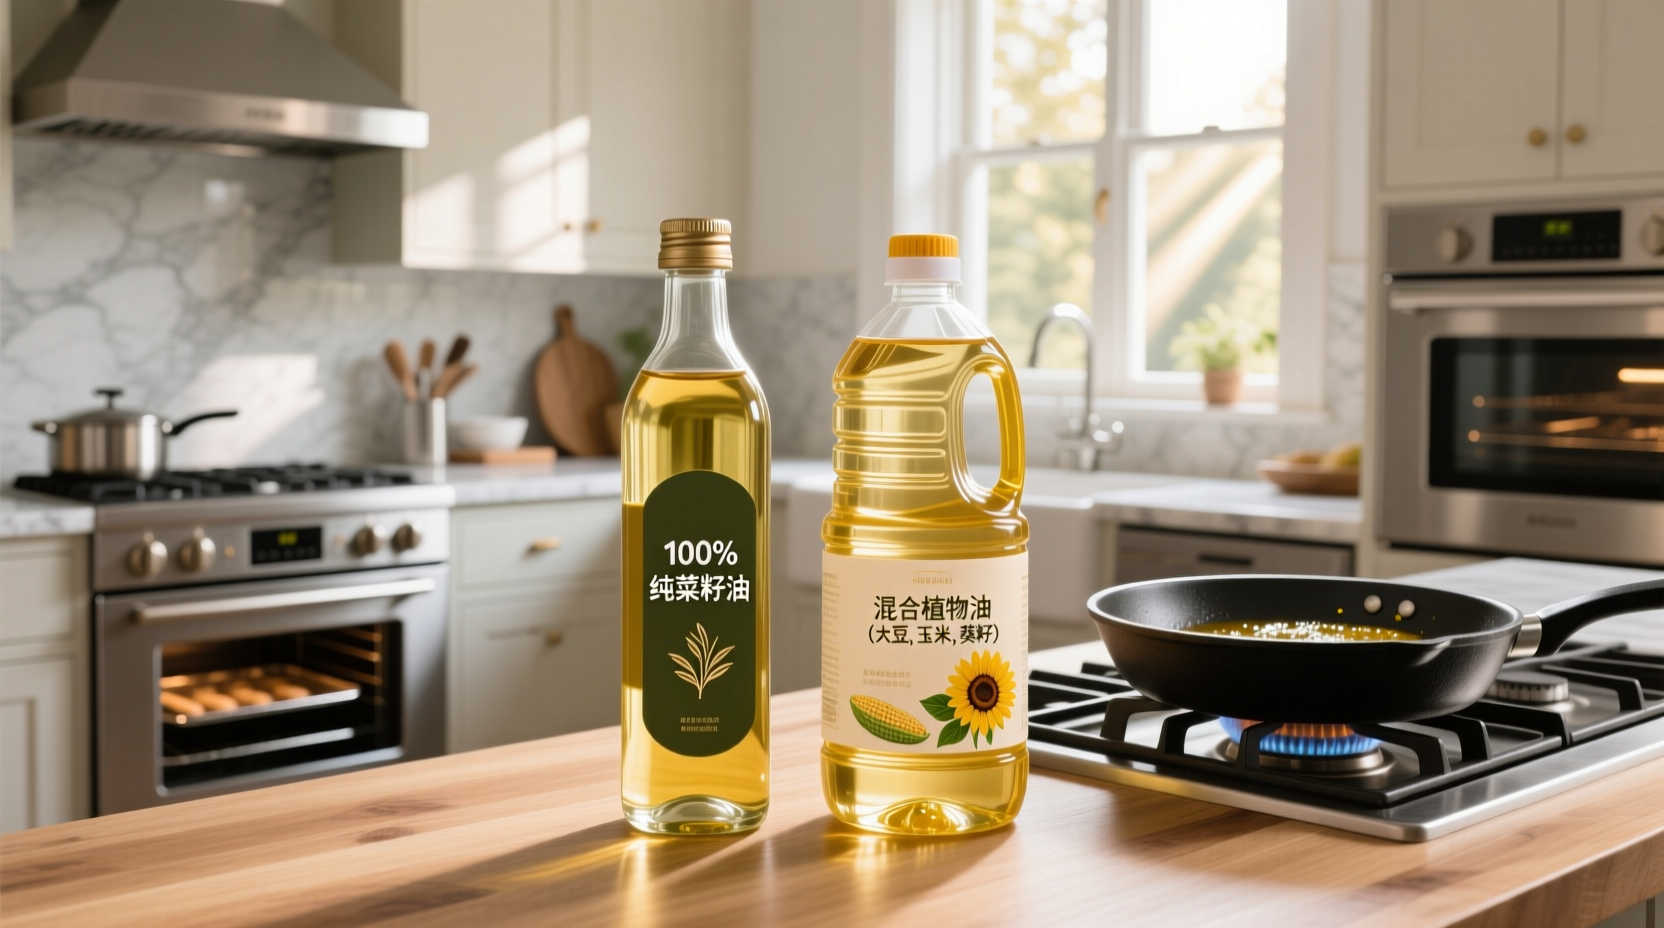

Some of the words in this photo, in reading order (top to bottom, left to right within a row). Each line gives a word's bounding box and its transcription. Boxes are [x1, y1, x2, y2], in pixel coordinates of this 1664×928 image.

[663, 539, 738, 566] 100%
[649, 573, 750, 603] 纯菜籽油
[873, 594, 992, 621] 混合植物油
